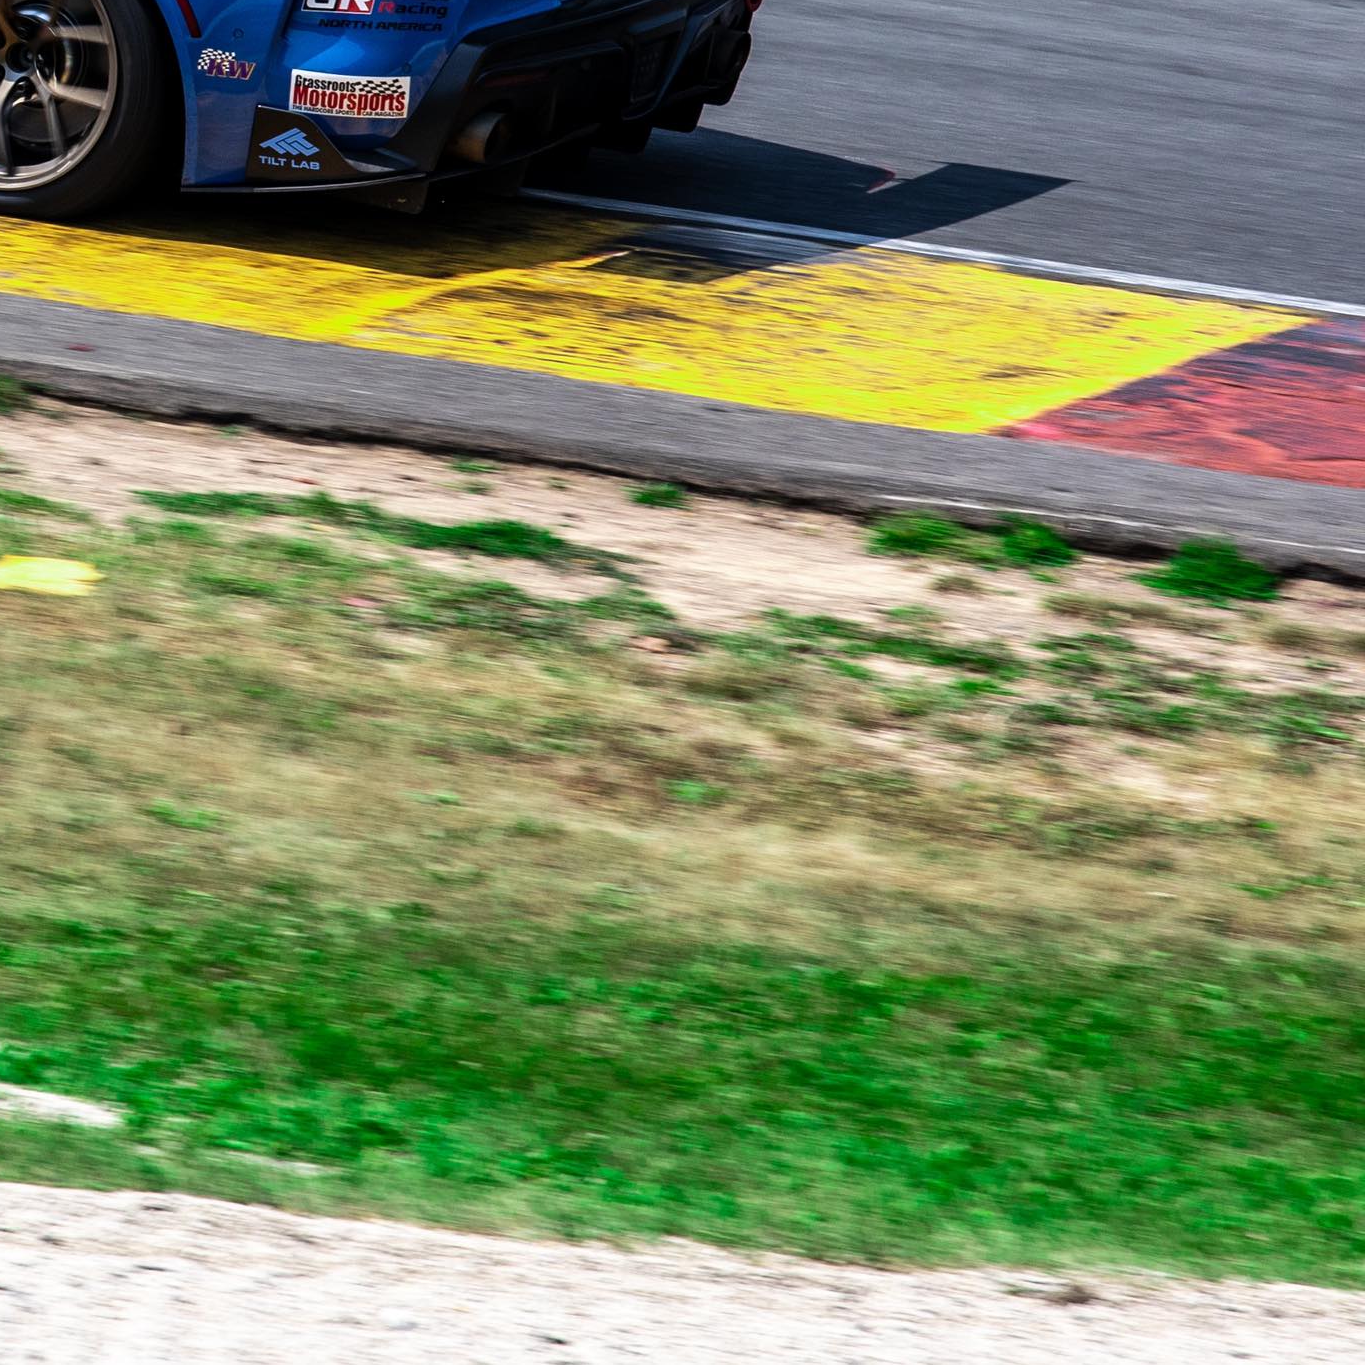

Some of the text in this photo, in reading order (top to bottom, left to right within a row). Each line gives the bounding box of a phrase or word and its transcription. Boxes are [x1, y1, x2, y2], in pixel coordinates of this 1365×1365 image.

[378, 1, 448, 19] Racing
[318, 18, 443, 32] NORTH AMERICA
[205, 58, 256, 81] KW
[295, 74, 356, 93] Grassroots
[292, 85, 406, 116] Motorsports
[304, 106, 334, 114] HARDCORE
[259, 155, 320, 170] TILT LAB
